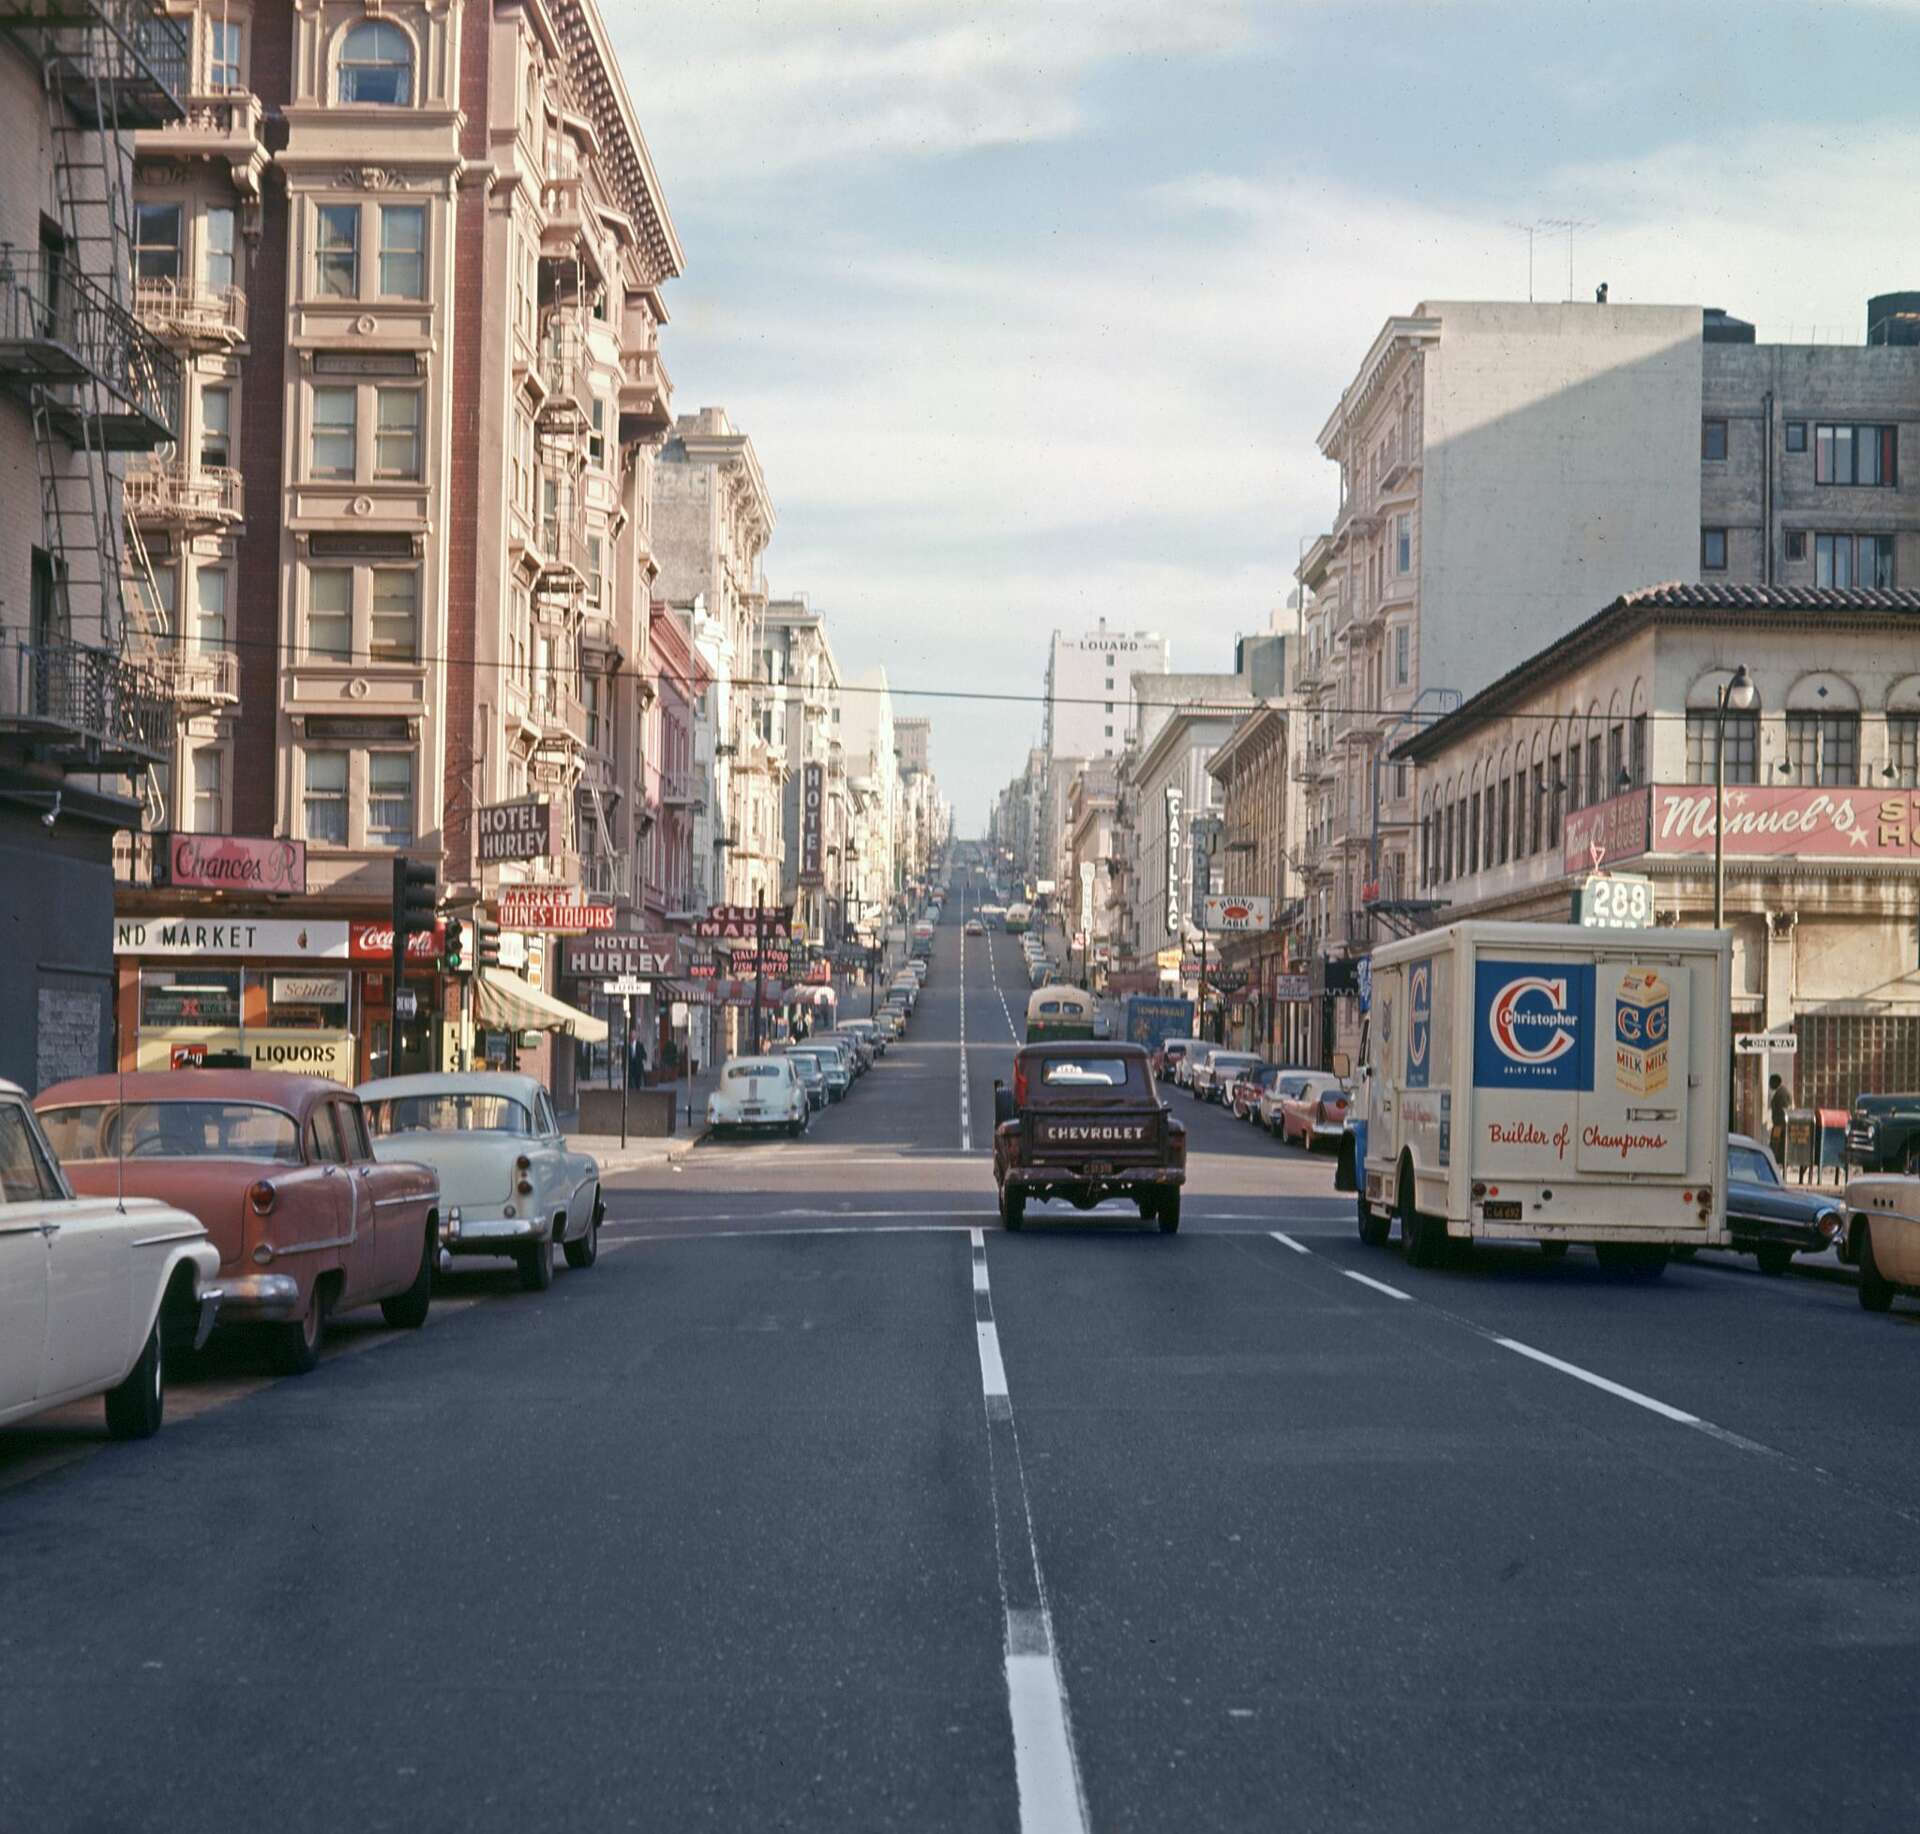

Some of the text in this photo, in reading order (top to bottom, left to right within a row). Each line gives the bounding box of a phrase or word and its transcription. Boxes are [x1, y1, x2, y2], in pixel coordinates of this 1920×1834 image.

[481, 806, 541, 832] HOTEL
[807, 769, 820, 871] HOTEL
[1661, 795, 1854, 839] Manuel's
[484, 831, 547, 858] HURLEY
[175, 840, 297, 885] Chances R
[1169, 799, 1180, 930] CADILLAC
[505, 891, 573, 906] MARKET
[553, 907, 614, 927] LIQUORS
[1222, 916, 1250, 928] TABLE
[162, 925, 257, 948] MARKET
[360, 927, 432, 951] Cocaola
[701, 923, 786, 937] MARIA
[595, 936, 649, 949] HOTEL
[571, 953, 670, 973] HURLEY
[767, 950, 789, 962] FOOD
[733, 962, 789, 972] FISH ROTTO
[1500, 1007, 1578, 1027] Christopher
[255, 1045, 336, 1063] LIQUORS
[1775, 1040, 1796, 1048] WAY
[1616, 1050, 1668, 1073] MILK MILK
[1048, 1127, 1144, 1139] CHEVROLET
[1489, 1122, 1668, 1160] Builder of Champions
